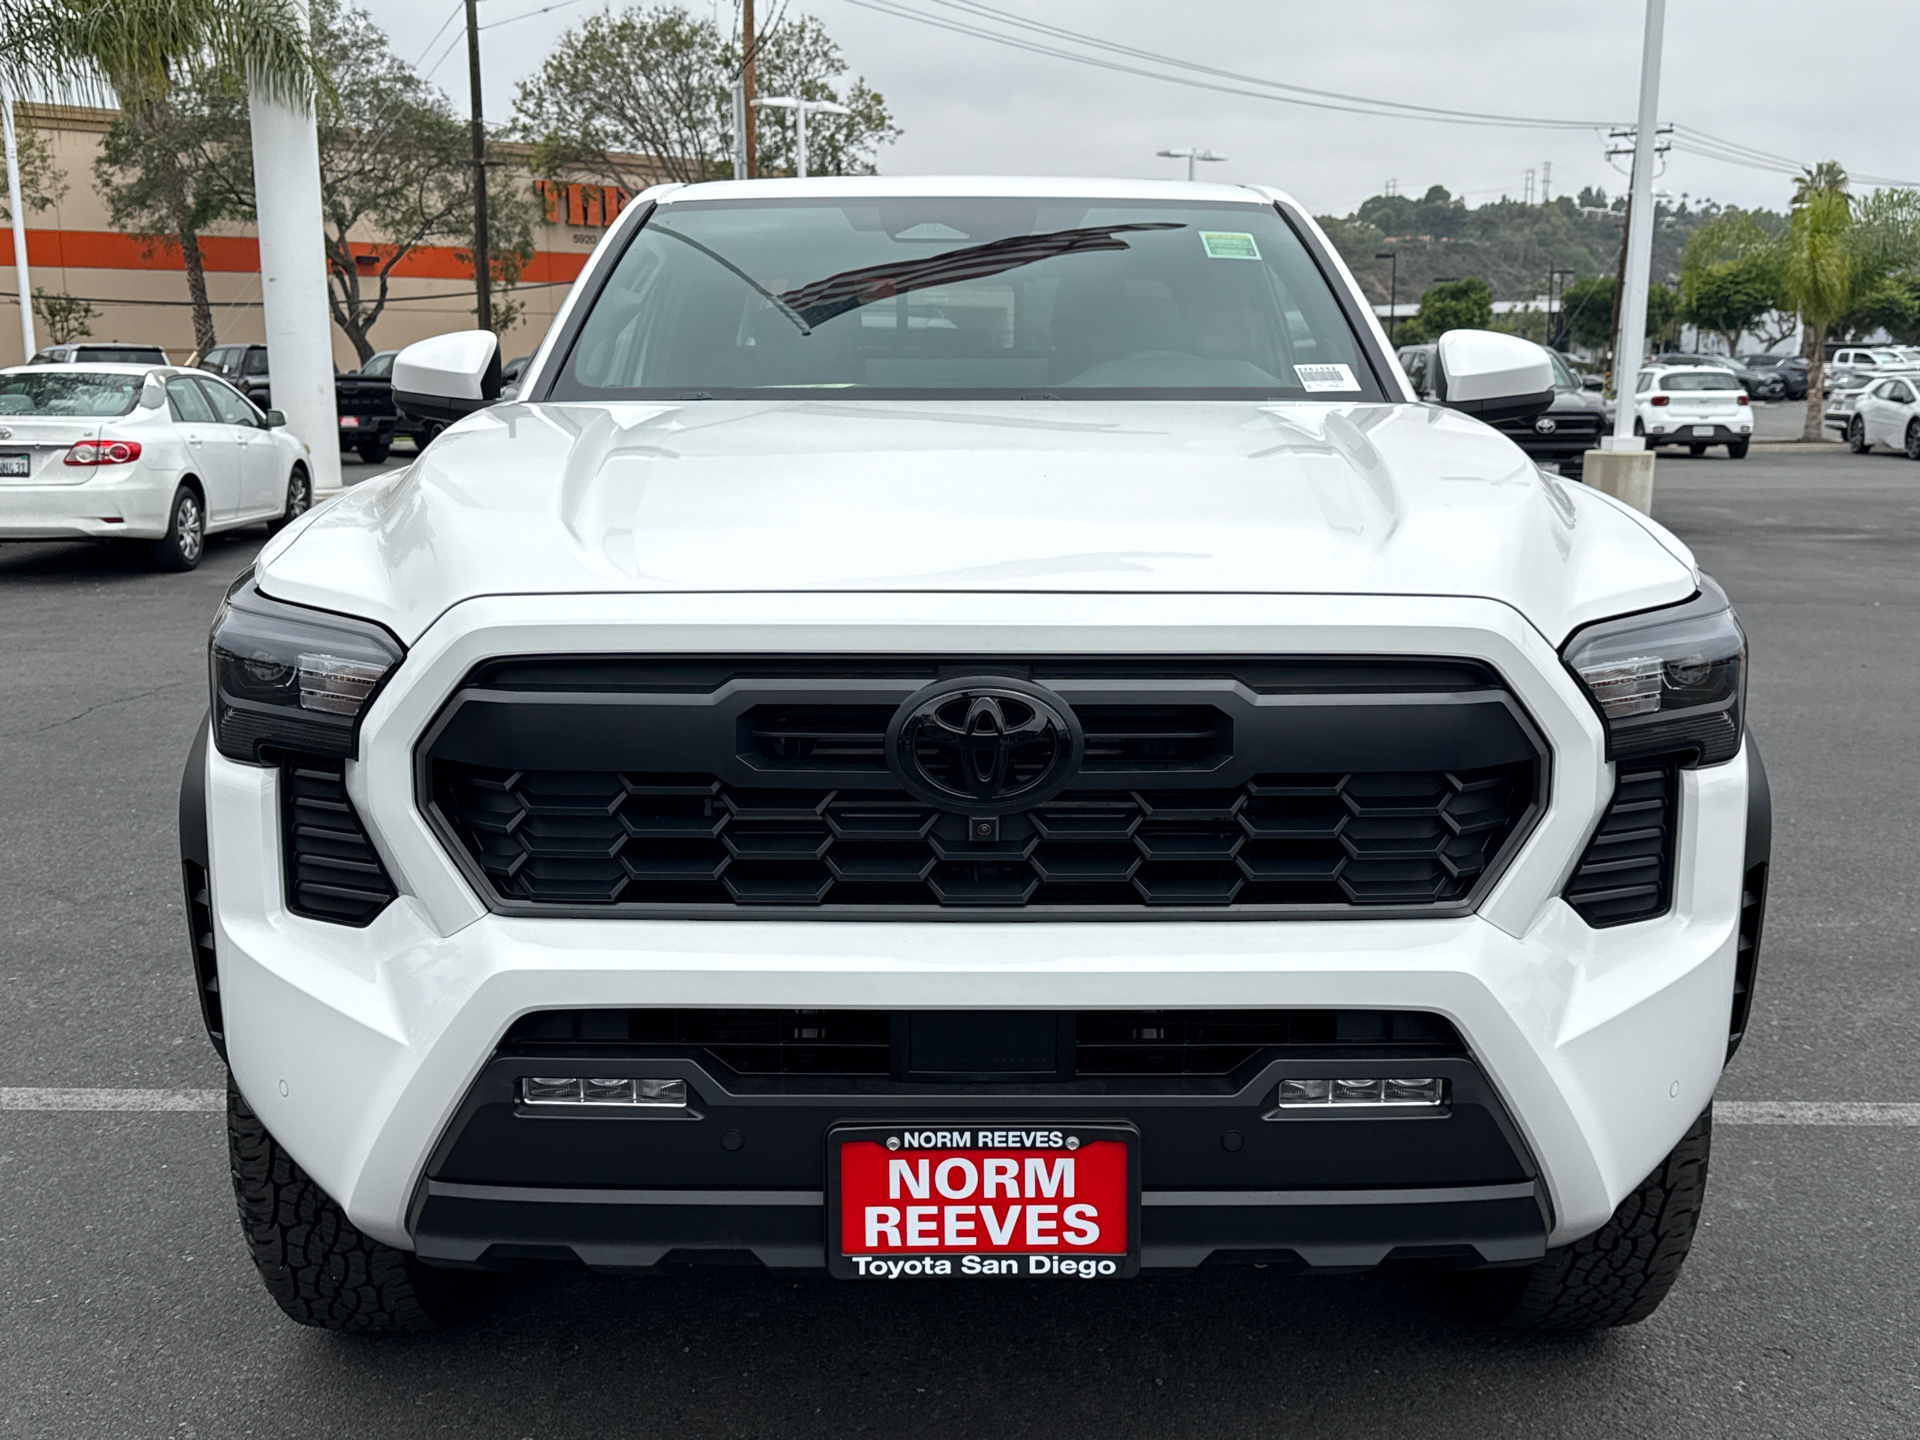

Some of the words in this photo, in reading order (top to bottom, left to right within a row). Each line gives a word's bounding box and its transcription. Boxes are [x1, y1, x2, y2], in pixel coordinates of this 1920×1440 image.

[573, 233, 597, 244] 5920
[904, 1131, 971, 1148] NORM
[978, 1131, 1063, 1148] REEVES
[889, 1157, 1075, 1199] NORM
[865, 1204, 1100, 1247] REEVES
[852, 1256, 952, 1279] Toyota
[961, 1255, 1018, 1275] San
[1029, 1255, 1116, 1279] Diego
